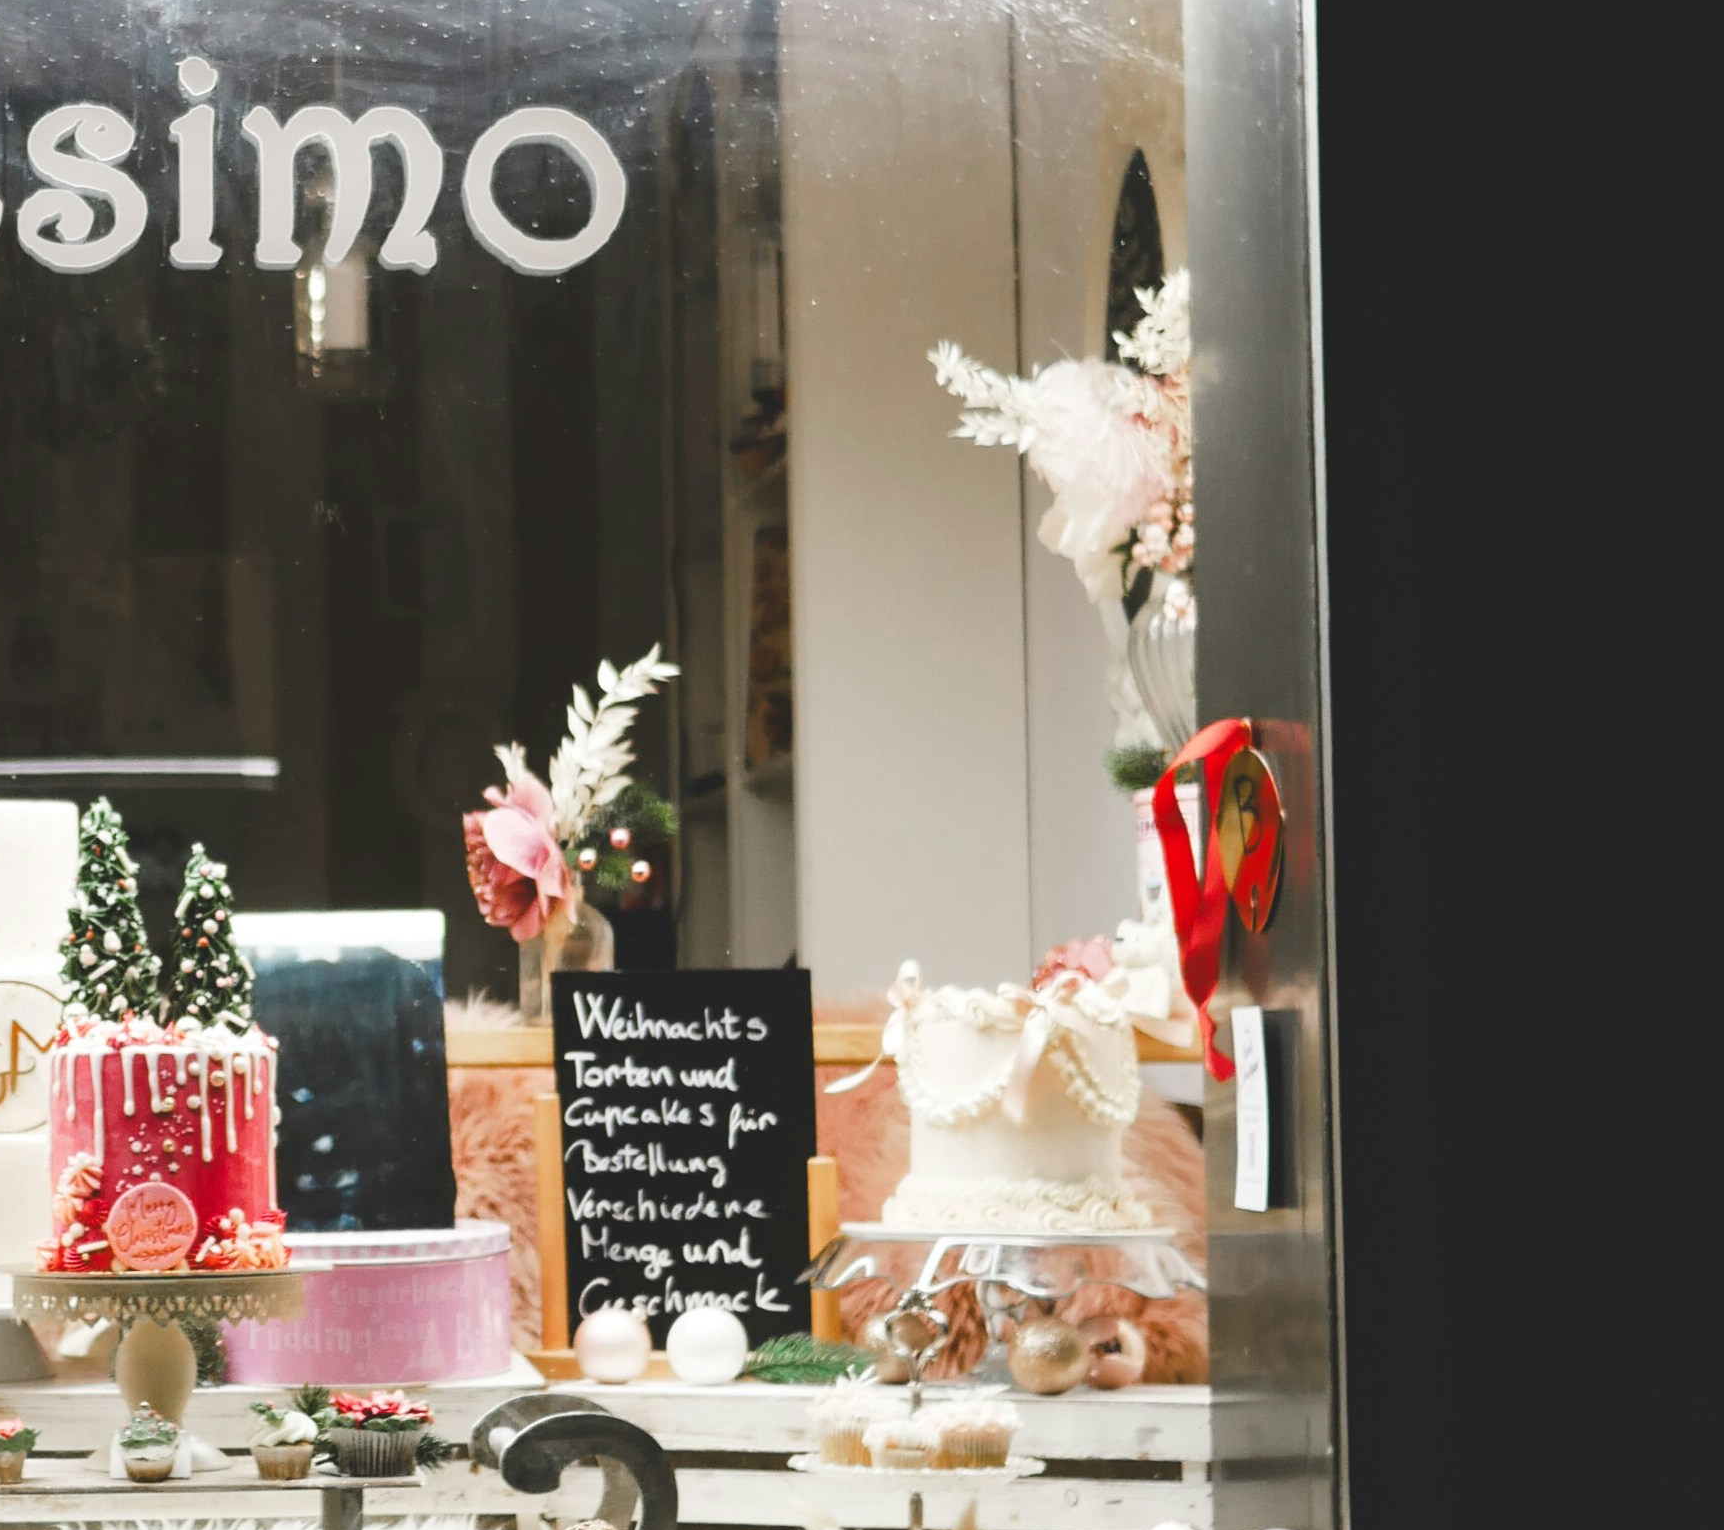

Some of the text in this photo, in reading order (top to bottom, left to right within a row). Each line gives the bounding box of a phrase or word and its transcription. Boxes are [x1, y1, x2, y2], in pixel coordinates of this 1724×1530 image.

[572, 990, 769, 1042] Weihnachts
[563, 1050, 739, 1092] Torten und
[727, 1101, 778, 1150] für
[563, 1138, 728, 1189] Bestellung
[566, 1185, 772, 1223] Verschiedene
[581, 1225, 763, 1281] Menge und
